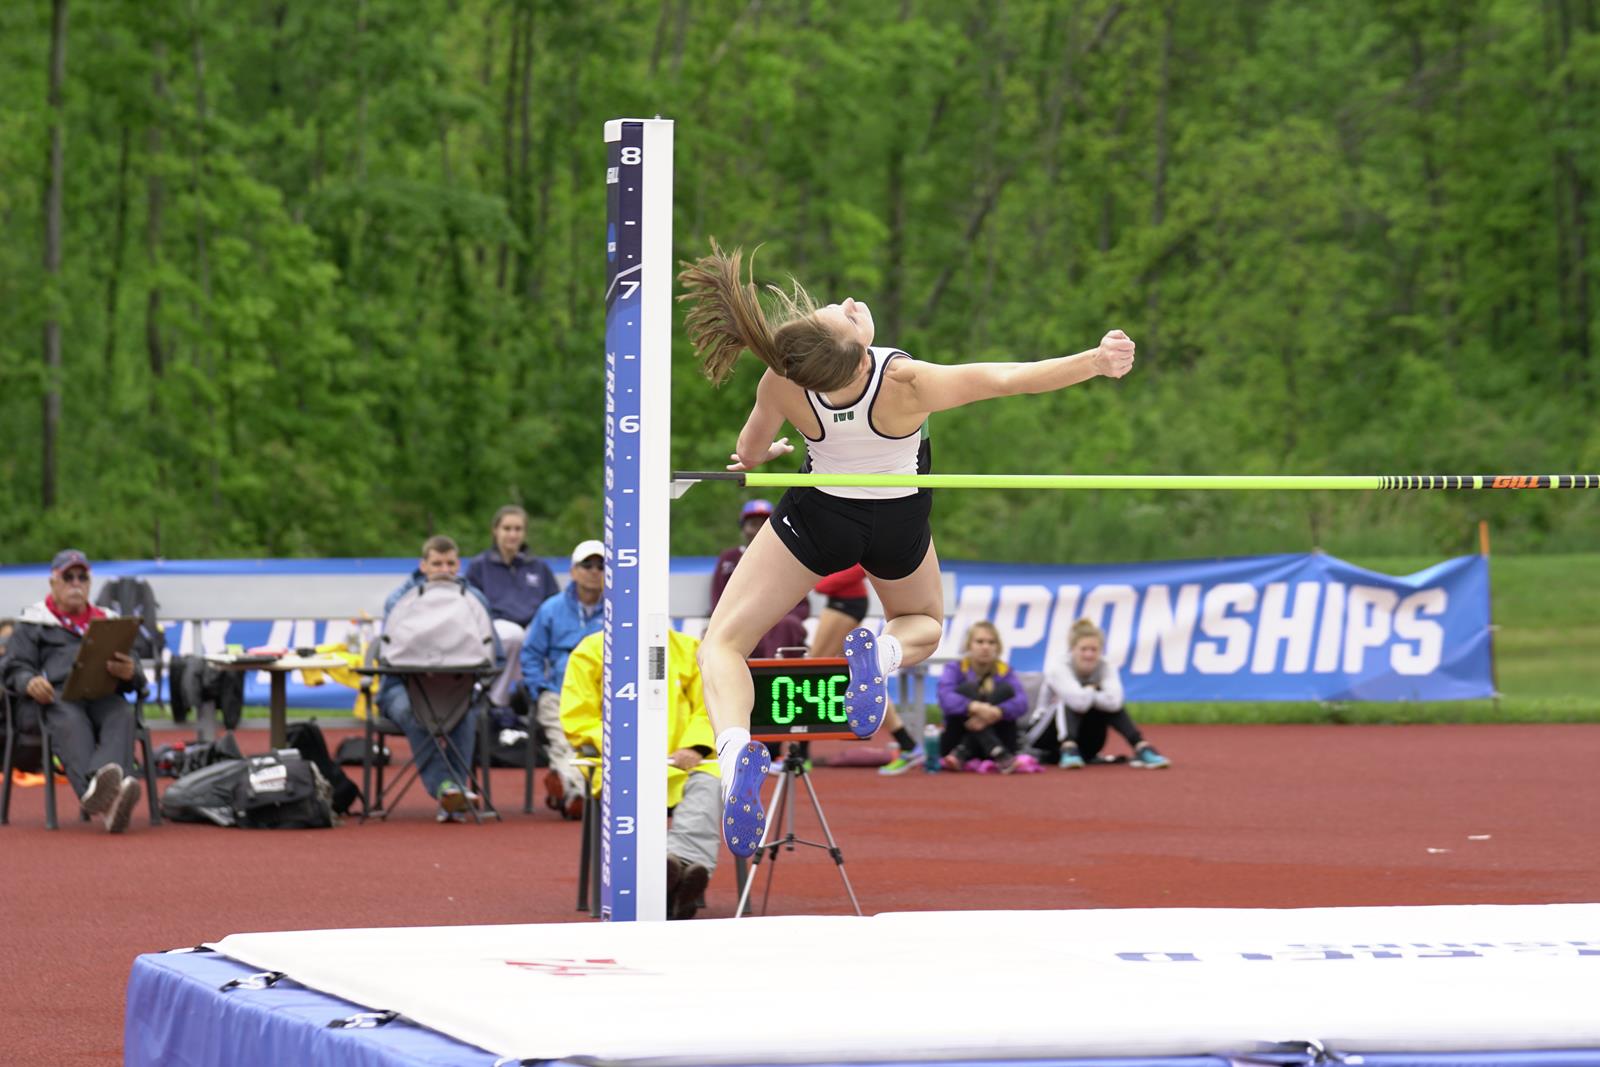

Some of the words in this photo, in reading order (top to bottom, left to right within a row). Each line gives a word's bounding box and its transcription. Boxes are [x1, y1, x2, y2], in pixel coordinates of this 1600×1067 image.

[620, 147, 642, 165] 8
[620, 281, 640, 299] 7
[605, 352, 616, 461] TRACK
[619, 415, 640, 433] 6
[833, 410, 855, 423] IWU
[1492, 475, 1541, 489] GILL
[604, 496, 614, 590] FIELD
[617, 549, 638, 568] 5
[615, 682, 637, 701] 4
[771, 675, 848, 725] 0:46
[602, 598, 613, 887] CHAMPIONSHIPS
[615, 816, 635, 835] 3
